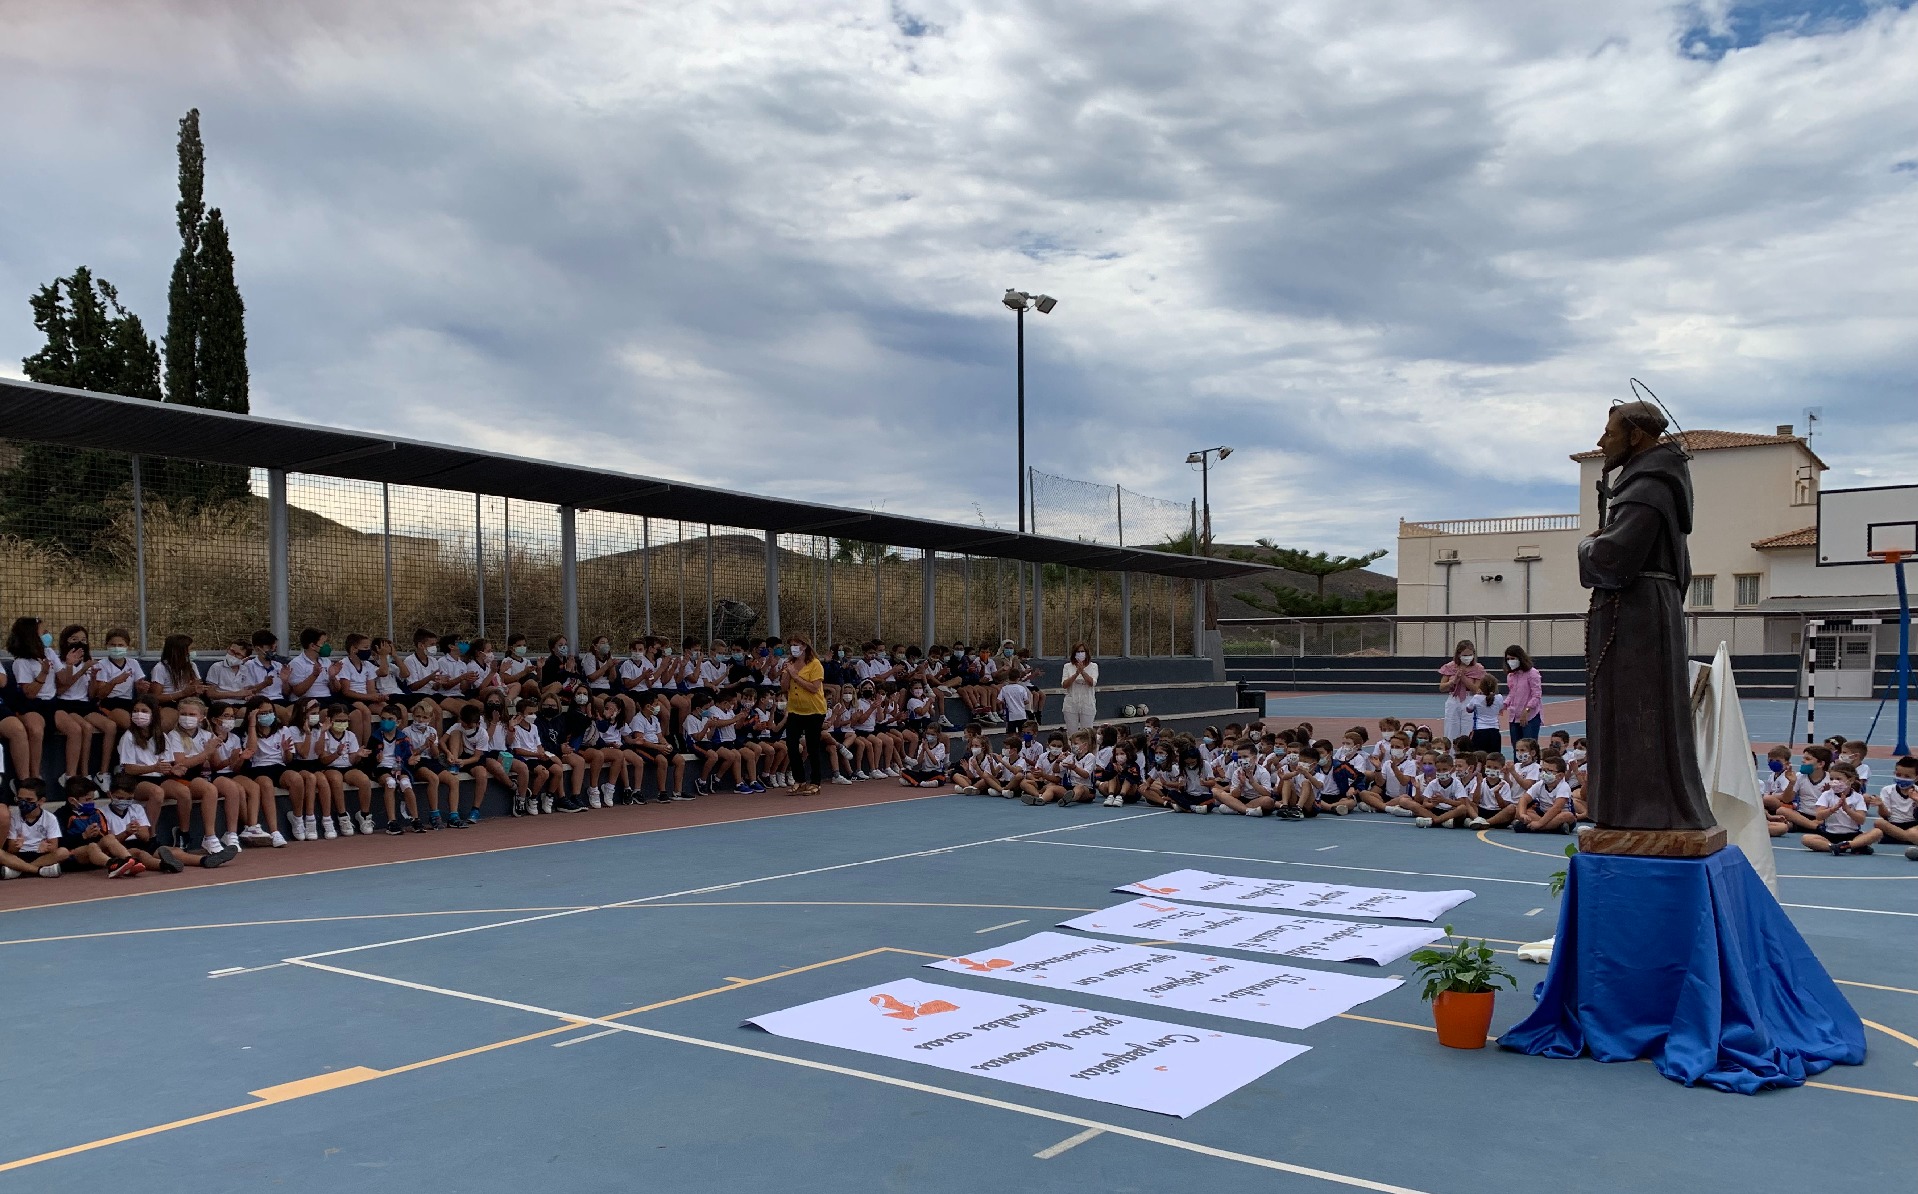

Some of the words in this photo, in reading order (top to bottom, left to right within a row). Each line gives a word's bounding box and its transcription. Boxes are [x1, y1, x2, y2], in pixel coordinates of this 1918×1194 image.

[1146, 953, 1177, 964] que
[1071, 976, 1106, 986] con
[972, 1004, 1048, 1032] grandes
[1062, 1015, 1124, 1040] gestos
[913, 1031, 973, 1051] cosas
[1146, 1033, 1201, 1048] Con
[970, 1040, 1075, 1071] haremos
[1069, 1042, 1158, 1081] pequeños
